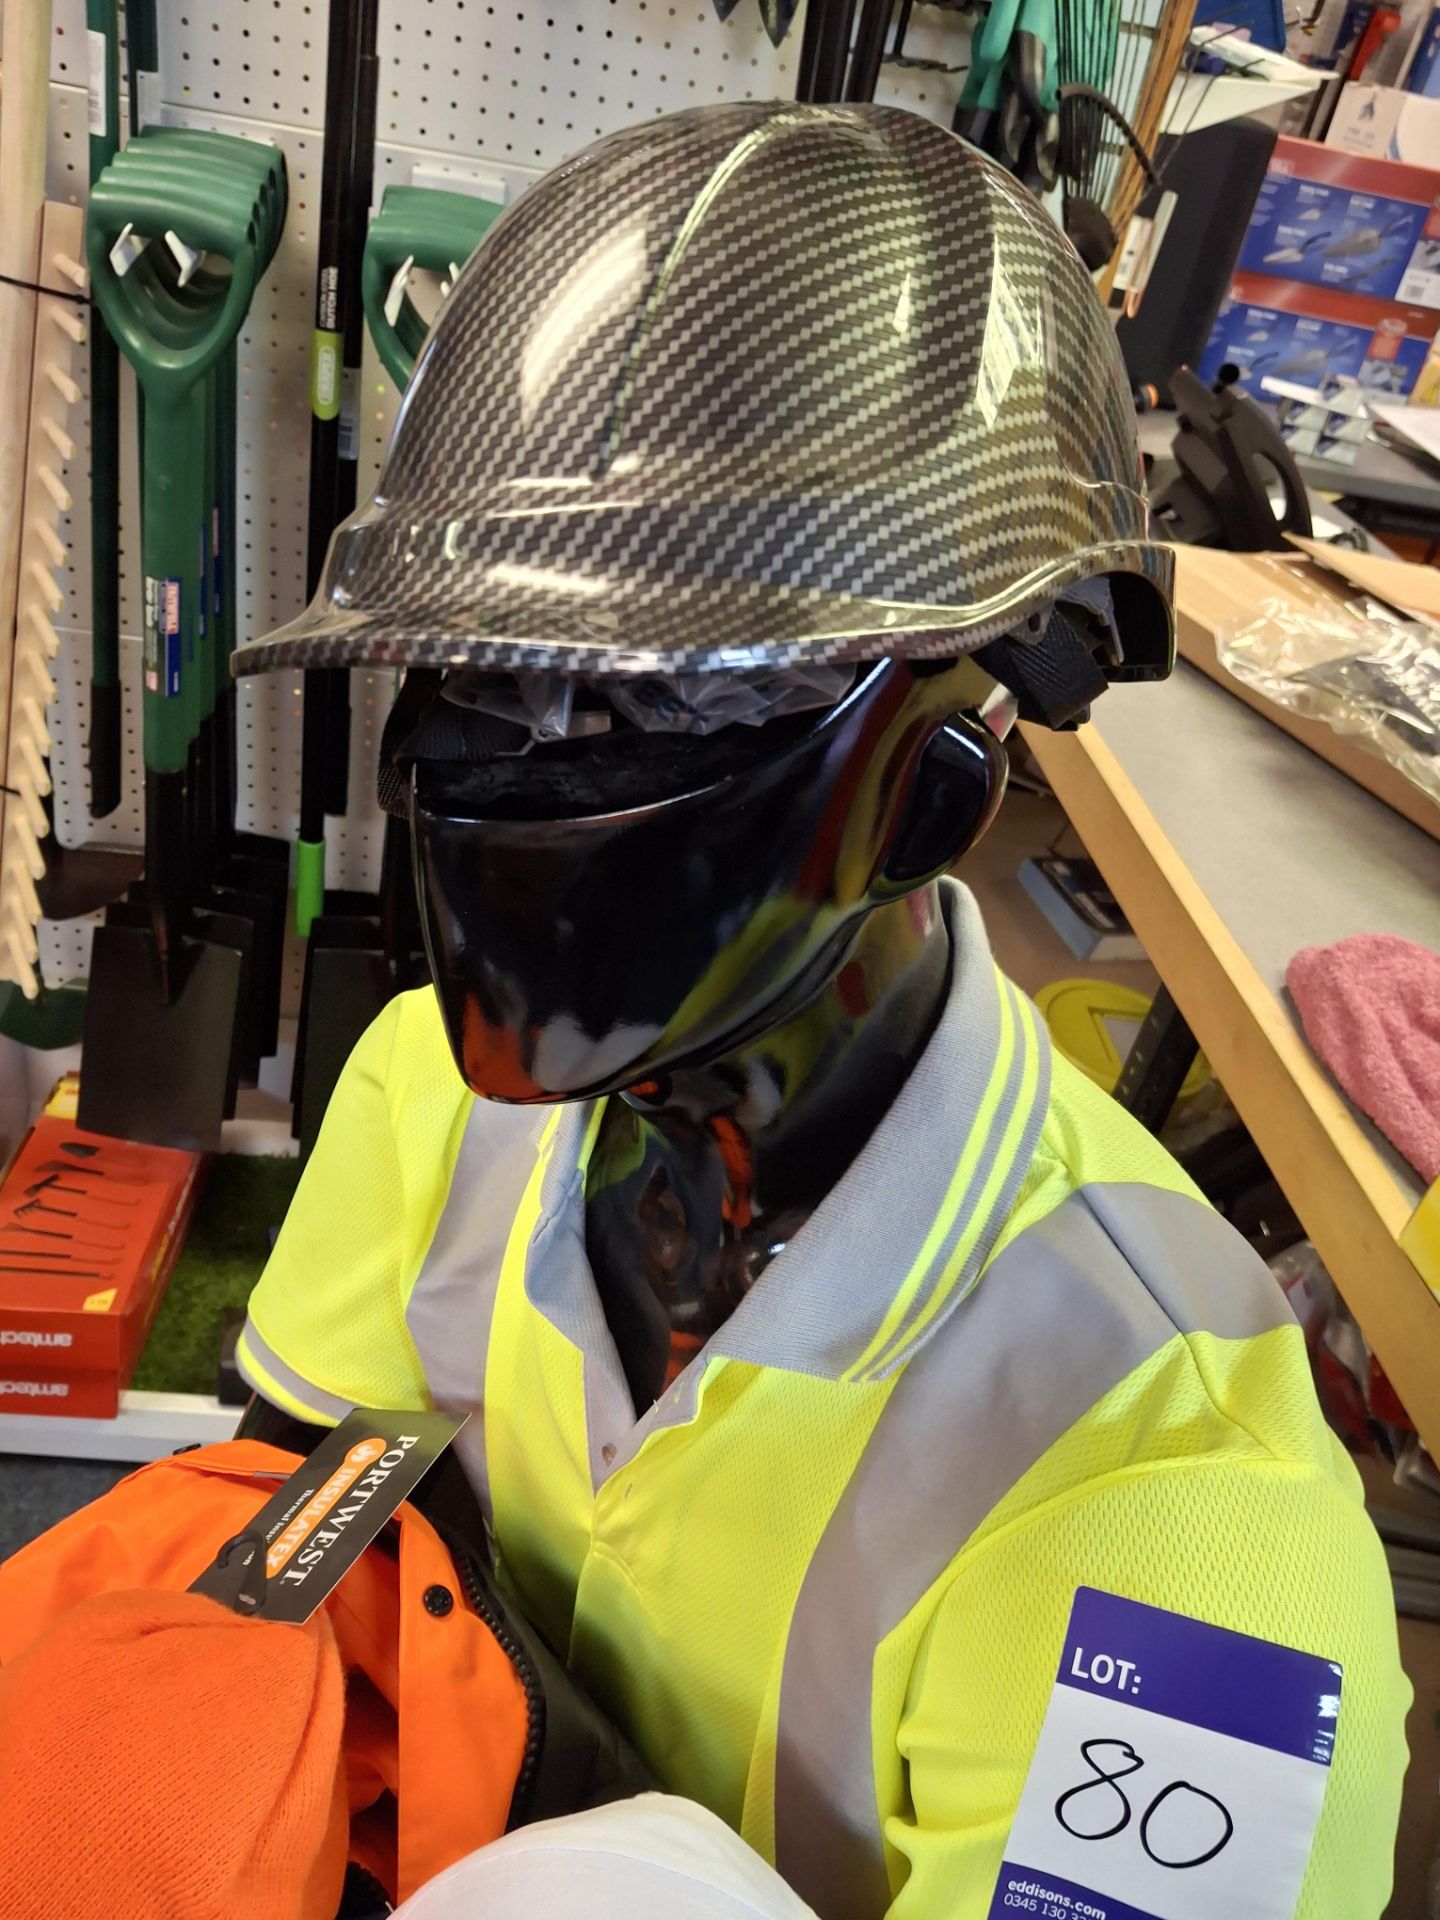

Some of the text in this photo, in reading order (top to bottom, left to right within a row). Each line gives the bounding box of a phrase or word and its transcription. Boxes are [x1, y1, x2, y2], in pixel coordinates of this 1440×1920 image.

[326, 266, 338, 329] DUTCH HOE
[266, 1468, 357, 1568] INSULATEX
[281, 1489, 315, 1522] Thermal
[293, 1435, 420, 1586] PORTWEST
[1071, 1647, 1142, 1695] LOT:
[1055, 1739, 1234, 1869] 80
[1003, 1893, 1038, 1912] 0345
[1041, 1903, 1067, 1920] 130
[1007, 1880, 1107, 1920] eddisons.com
